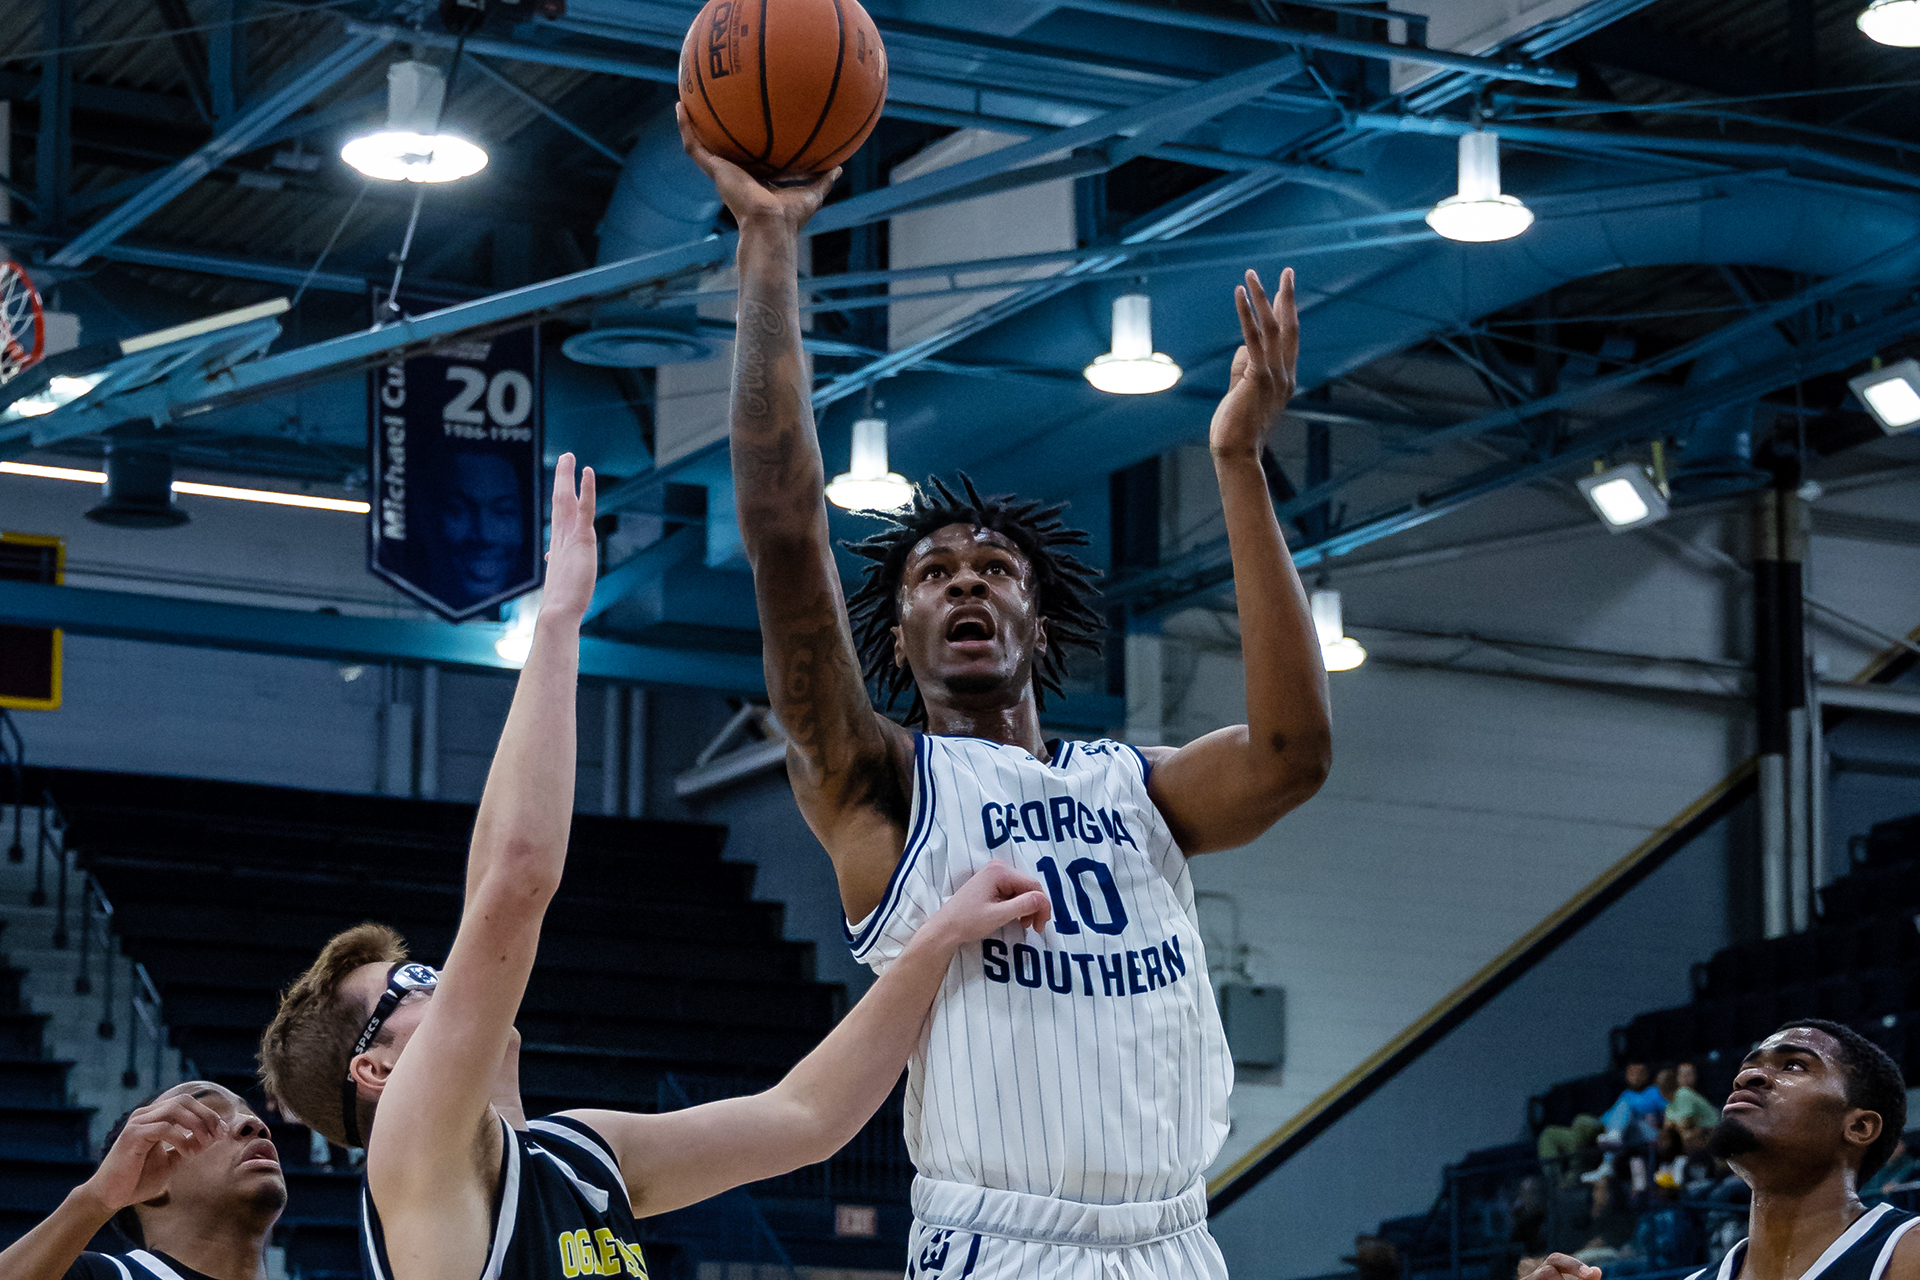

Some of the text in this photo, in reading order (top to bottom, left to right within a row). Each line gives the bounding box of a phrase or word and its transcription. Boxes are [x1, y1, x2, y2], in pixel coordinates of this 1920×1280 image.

[709, 2, 731, 79] PRO
[443, 366, 533, 426] 20
[381, 358, 406, 540] Michael Cu
[981, 795, 1141, 853] GEORGIA
[1036, 855, 1129, 936] 10
[981, 934, 1187, 997] SOUTHERN
[355, 1016, 380, 1054] SPECS
[558, 1227, 649, 1280] OGLE
